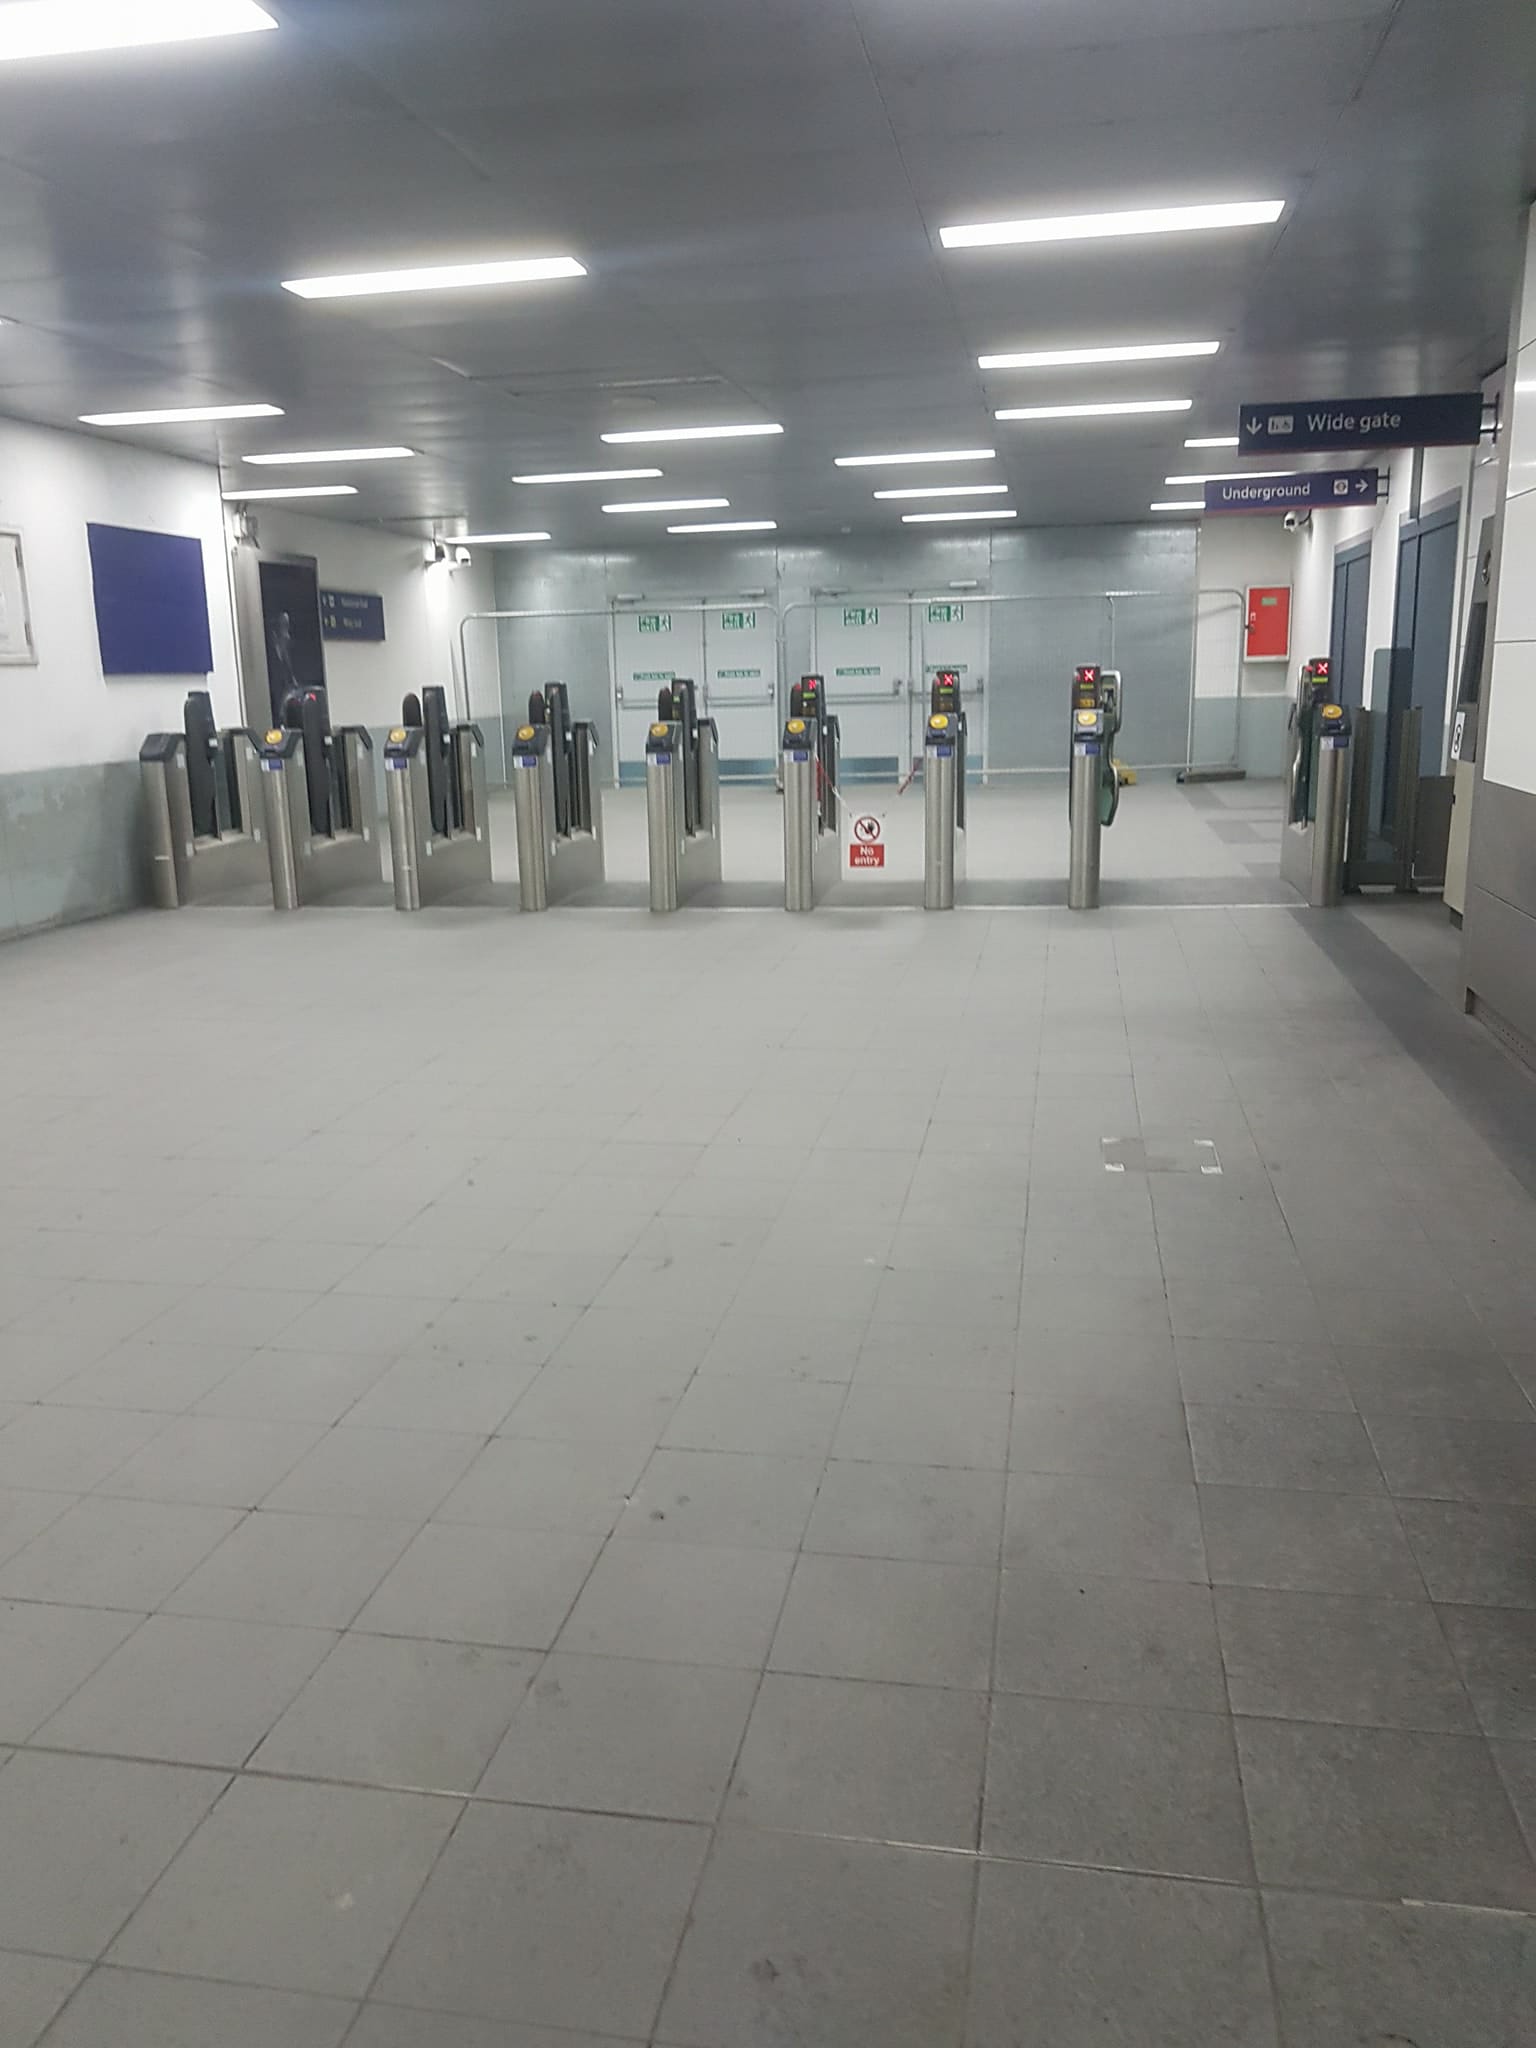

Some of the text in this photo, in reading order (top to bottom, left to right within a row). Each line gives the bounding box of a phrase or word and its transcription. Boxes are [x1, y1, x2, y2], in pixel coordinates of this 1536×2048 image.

[1307, 412, 1401, 434] Wide gate
[1222, 483, 1311, 500] Underground
[860, 846, 874, 856] No
[854, 856, 880, 866] entry
